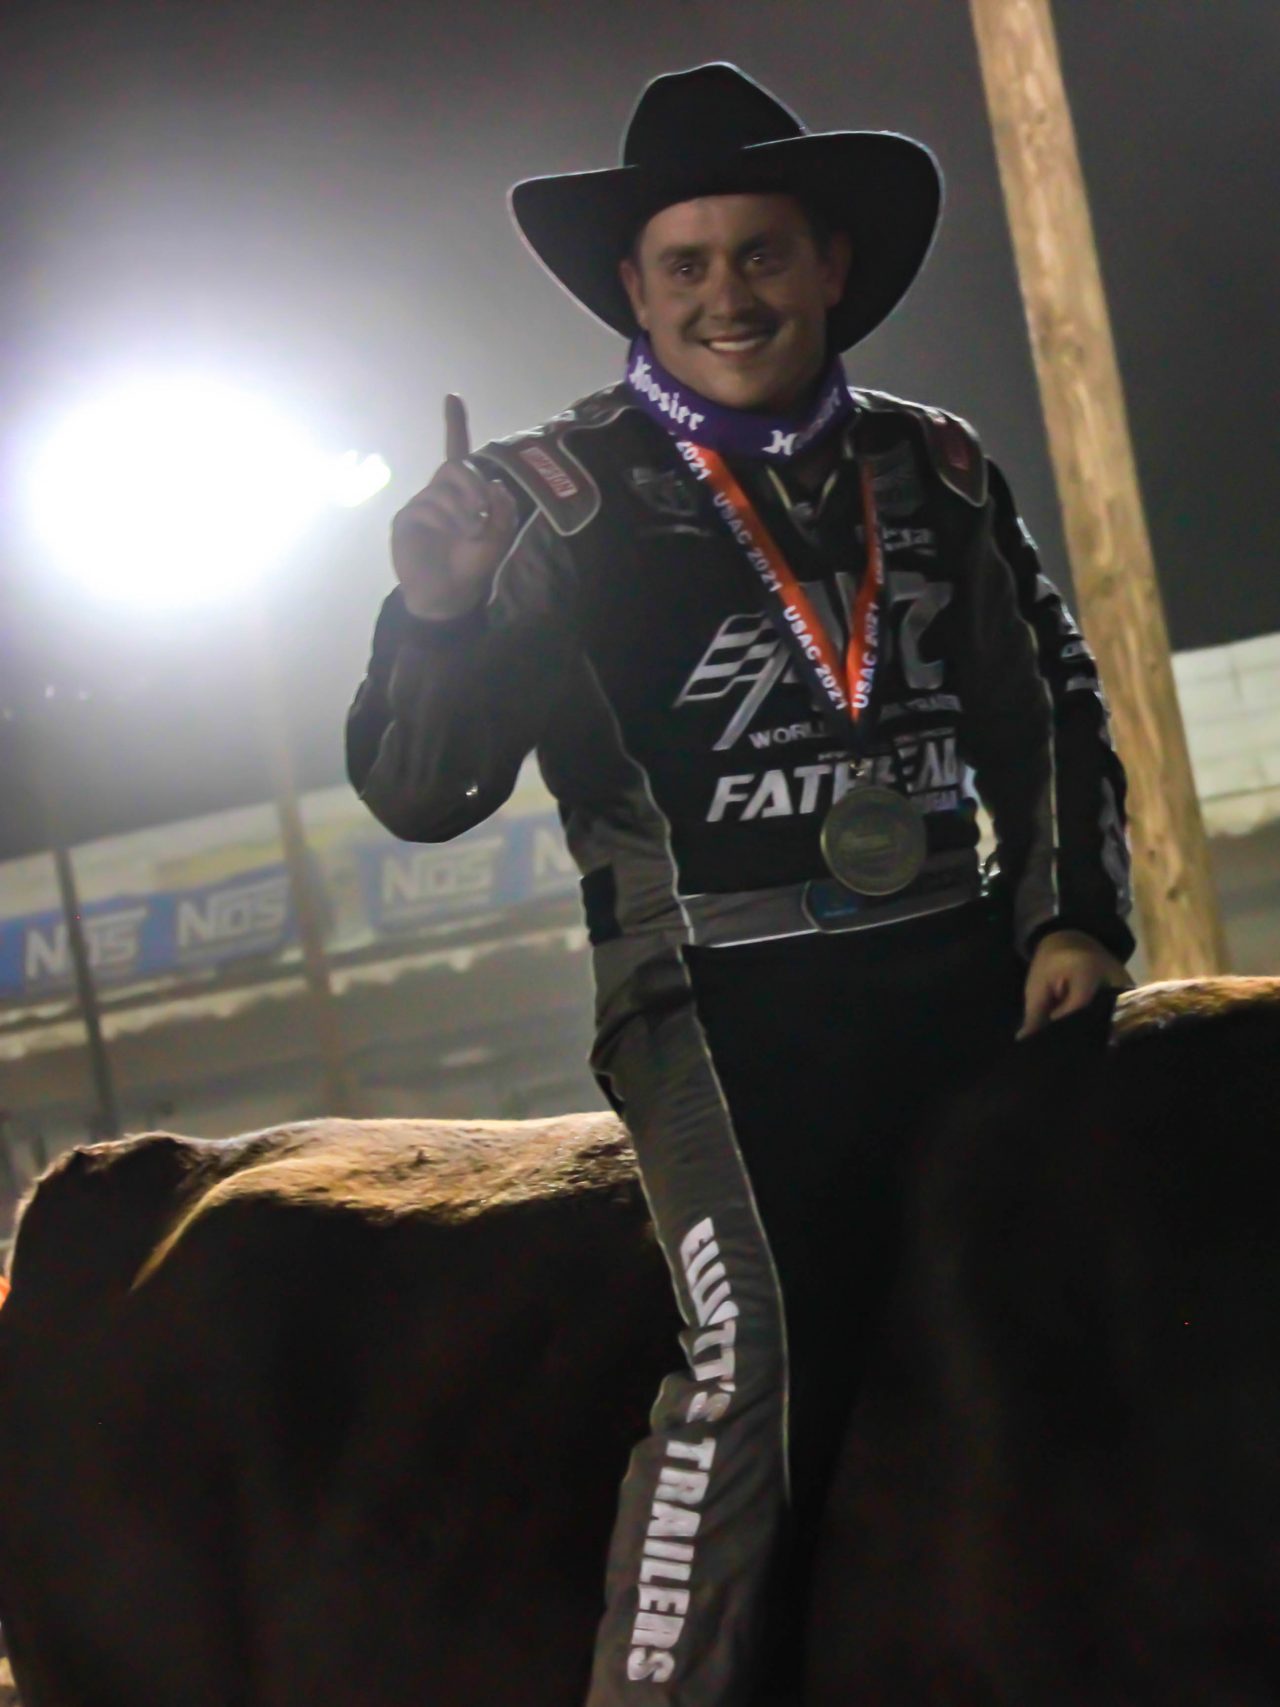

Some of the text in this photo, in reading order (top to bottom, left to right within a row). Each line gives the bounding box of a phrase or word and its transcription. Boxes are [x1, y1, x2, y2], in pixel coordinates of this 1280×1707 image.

[629, 355, 705, 431] Hoosier
[712, 491, 784, 593] USAC 2021
[783, 604, 822, 661] USAC
[815, 663, 849, 710] 2021
[852, 651, 877, 709] USAC
[626, 1436, 717, 1683] TRAILERS
